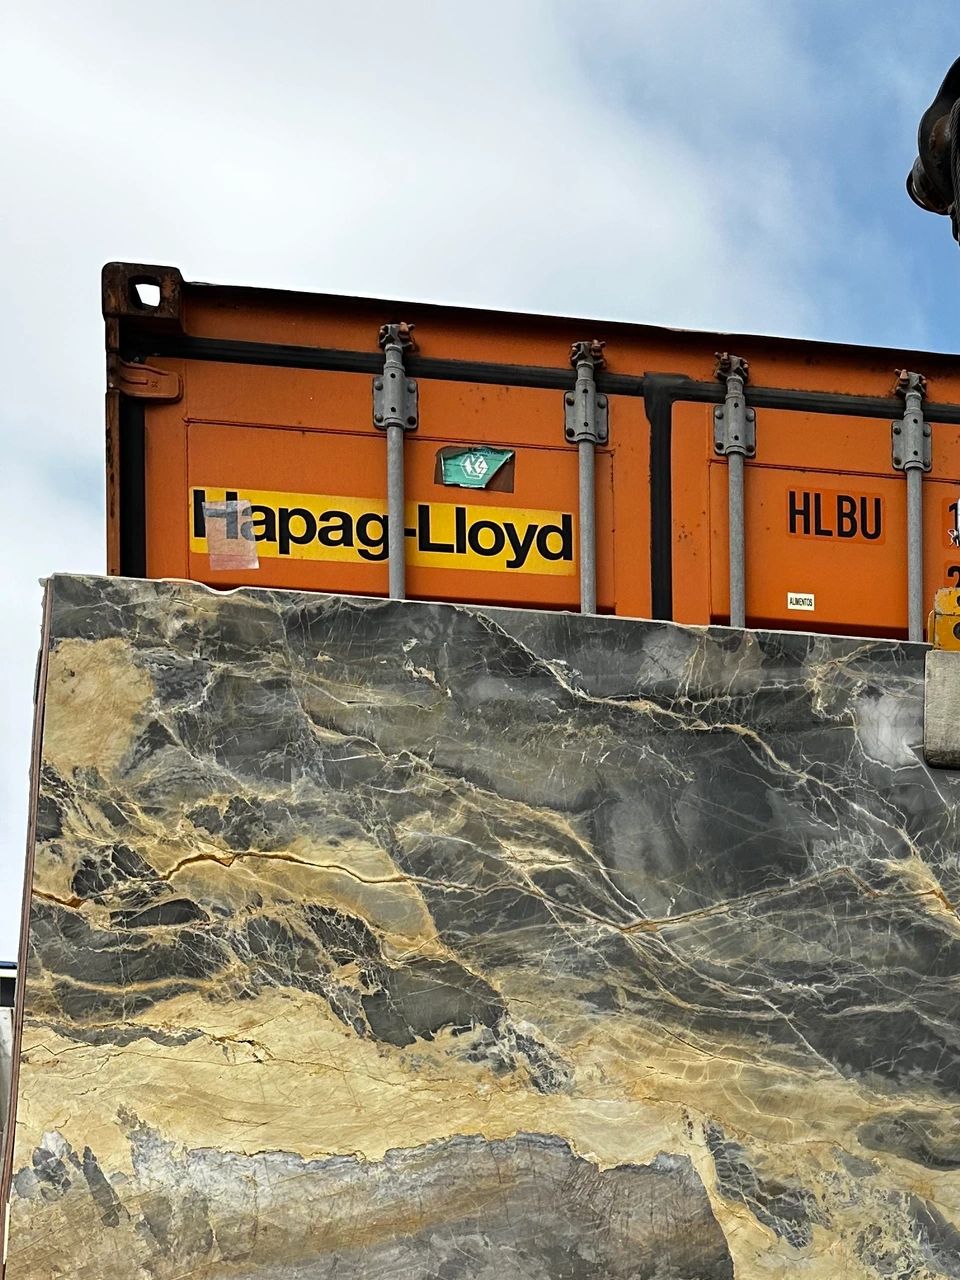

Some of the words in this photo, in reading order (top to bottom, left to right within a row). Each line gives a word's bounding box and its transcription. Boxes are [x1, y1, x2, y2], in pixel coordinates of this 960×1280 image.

[193, 489, 573, 569] Hapag-Lloyd
[789, 490, 882, 541] HLBU
[790, 596, 813, 607] ALIMENTOS
